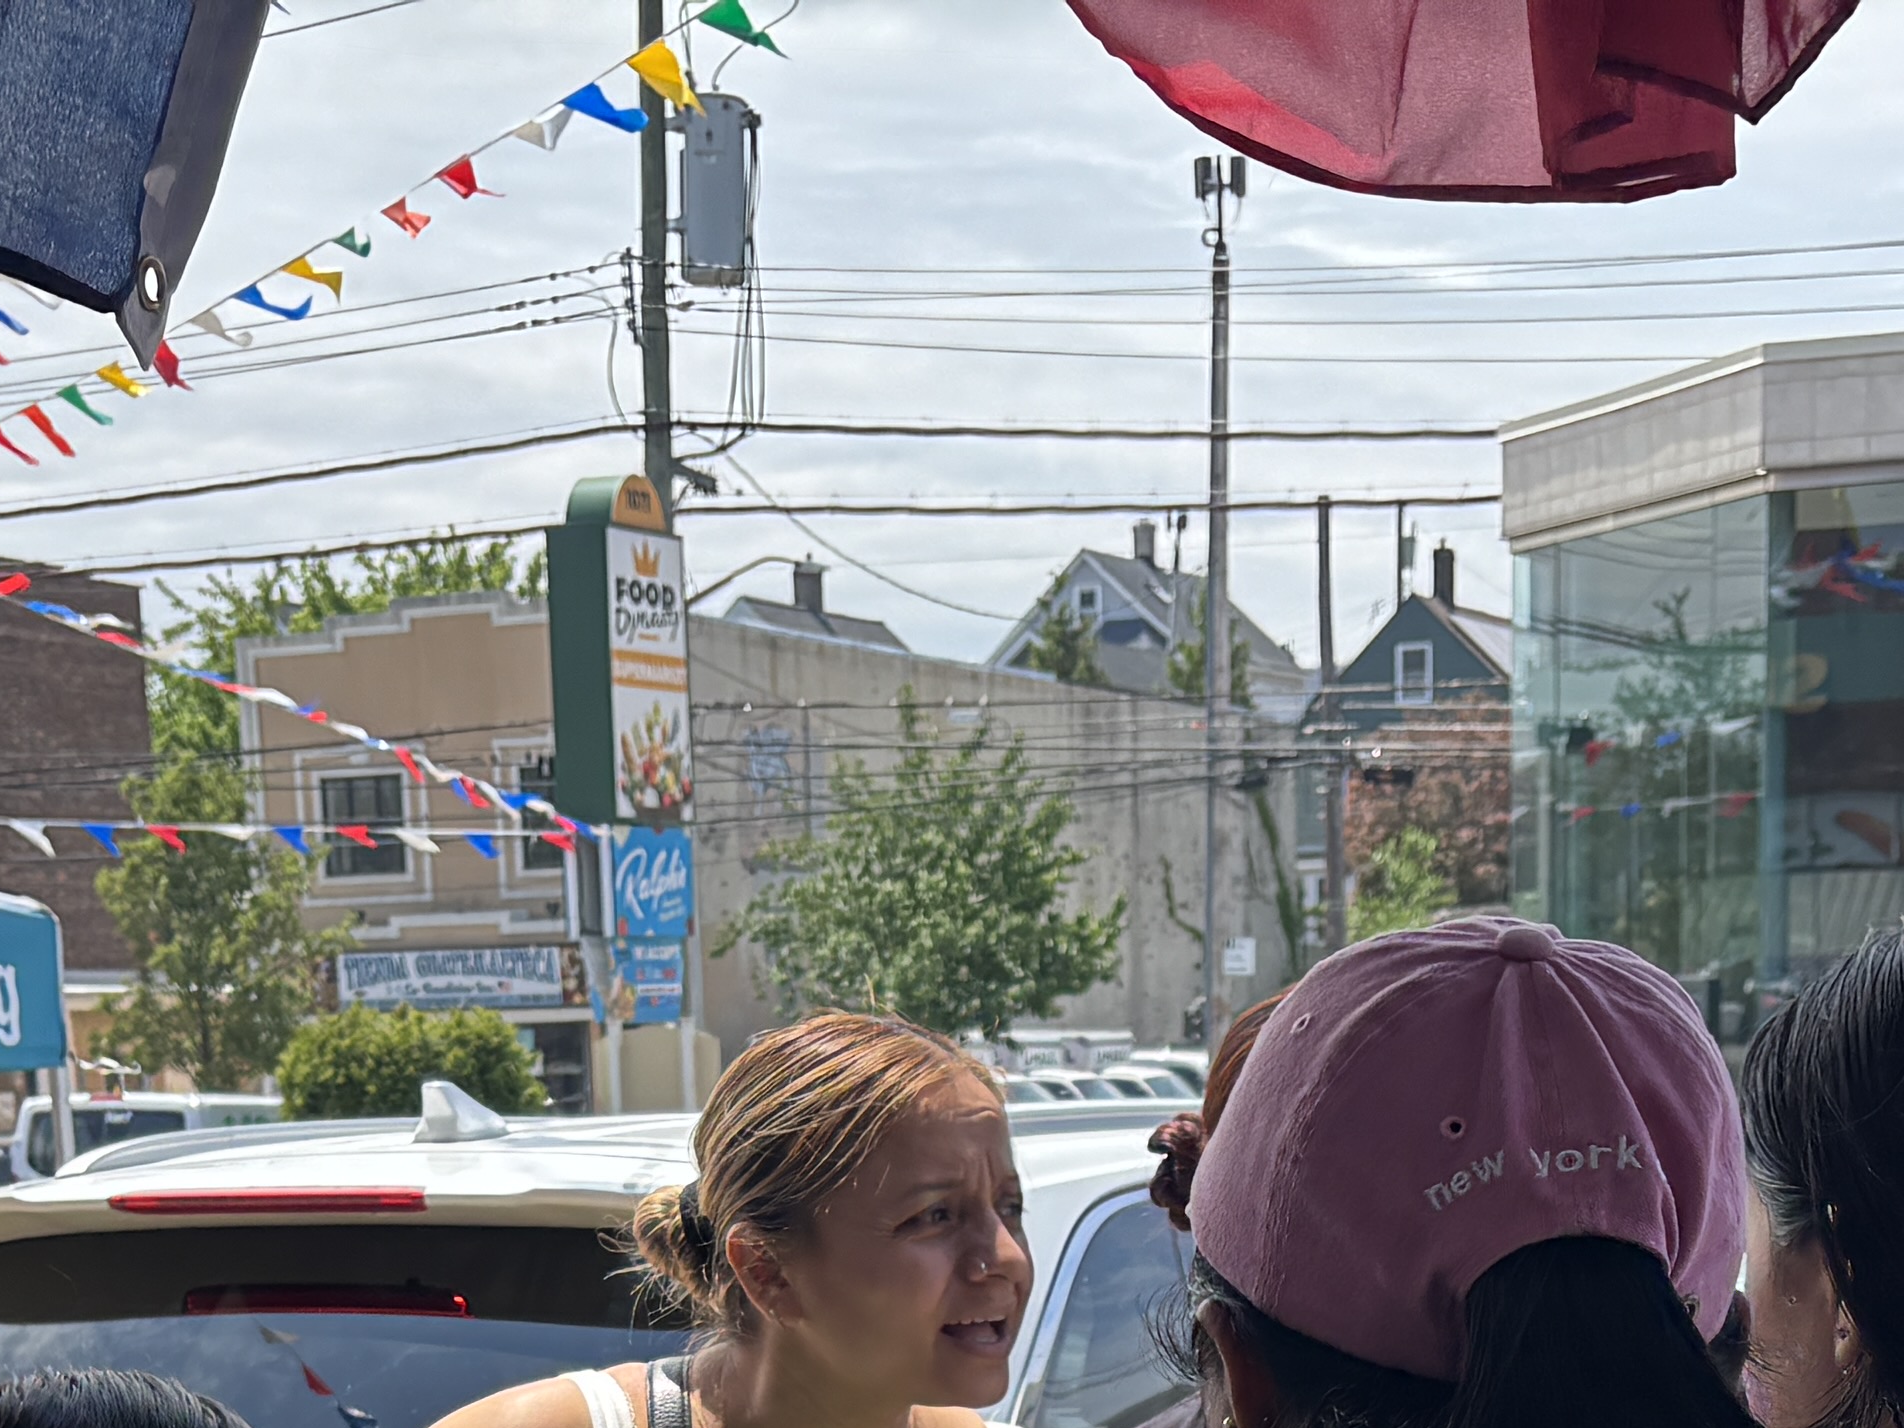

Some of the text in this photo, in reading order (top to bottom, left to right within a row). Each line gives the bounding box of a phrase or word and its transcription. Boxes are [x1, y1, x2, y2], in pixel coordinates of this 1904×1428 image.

[615, 576, 675, 611] FOOD
[1423, 1134, 1644, 1212] new york
